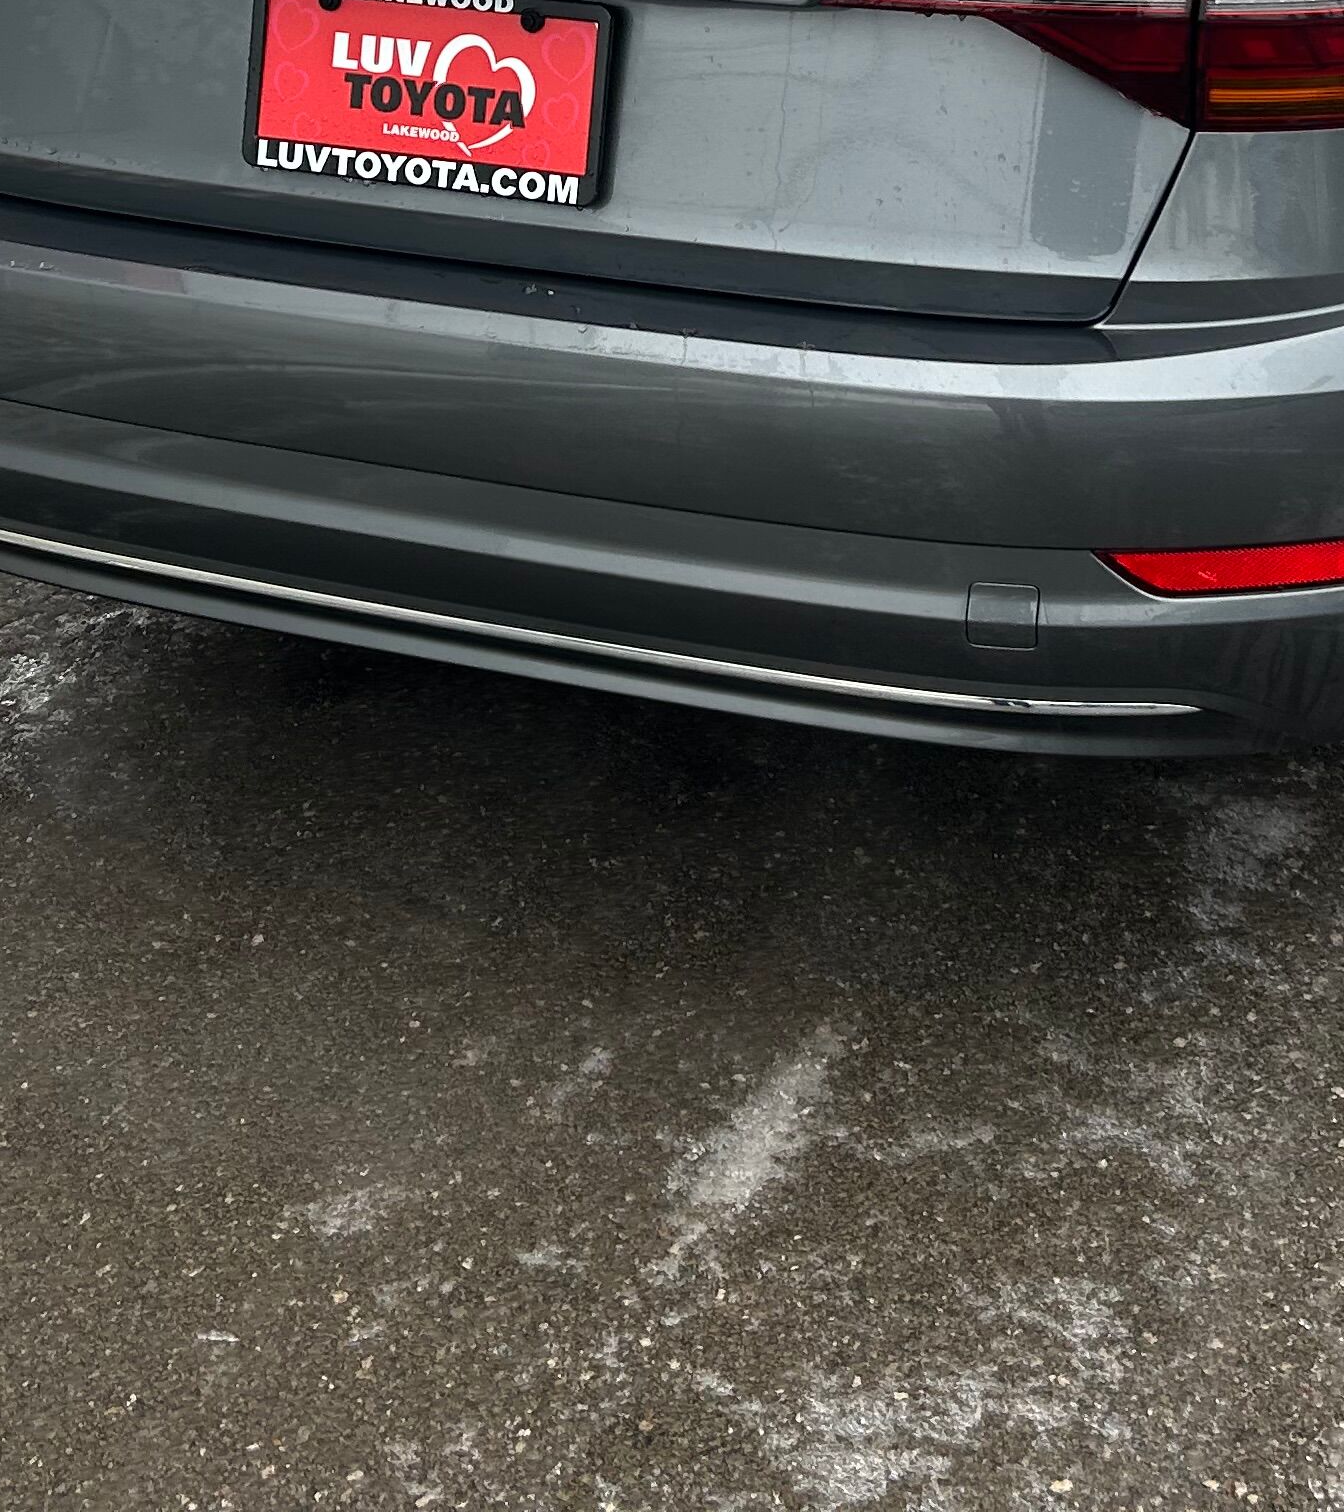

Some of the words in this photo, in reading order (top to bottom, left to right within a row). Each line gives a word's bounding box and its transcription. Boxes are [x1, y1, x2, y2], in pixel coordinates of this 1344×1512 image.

[331, 31, 432, 78] LUV
[344, 72, 525, 129] TOYOTA
[382, 123, 460, 143] LAKEWOOD
[256, 138, 580, 206] LUVTOYOTA.COM
